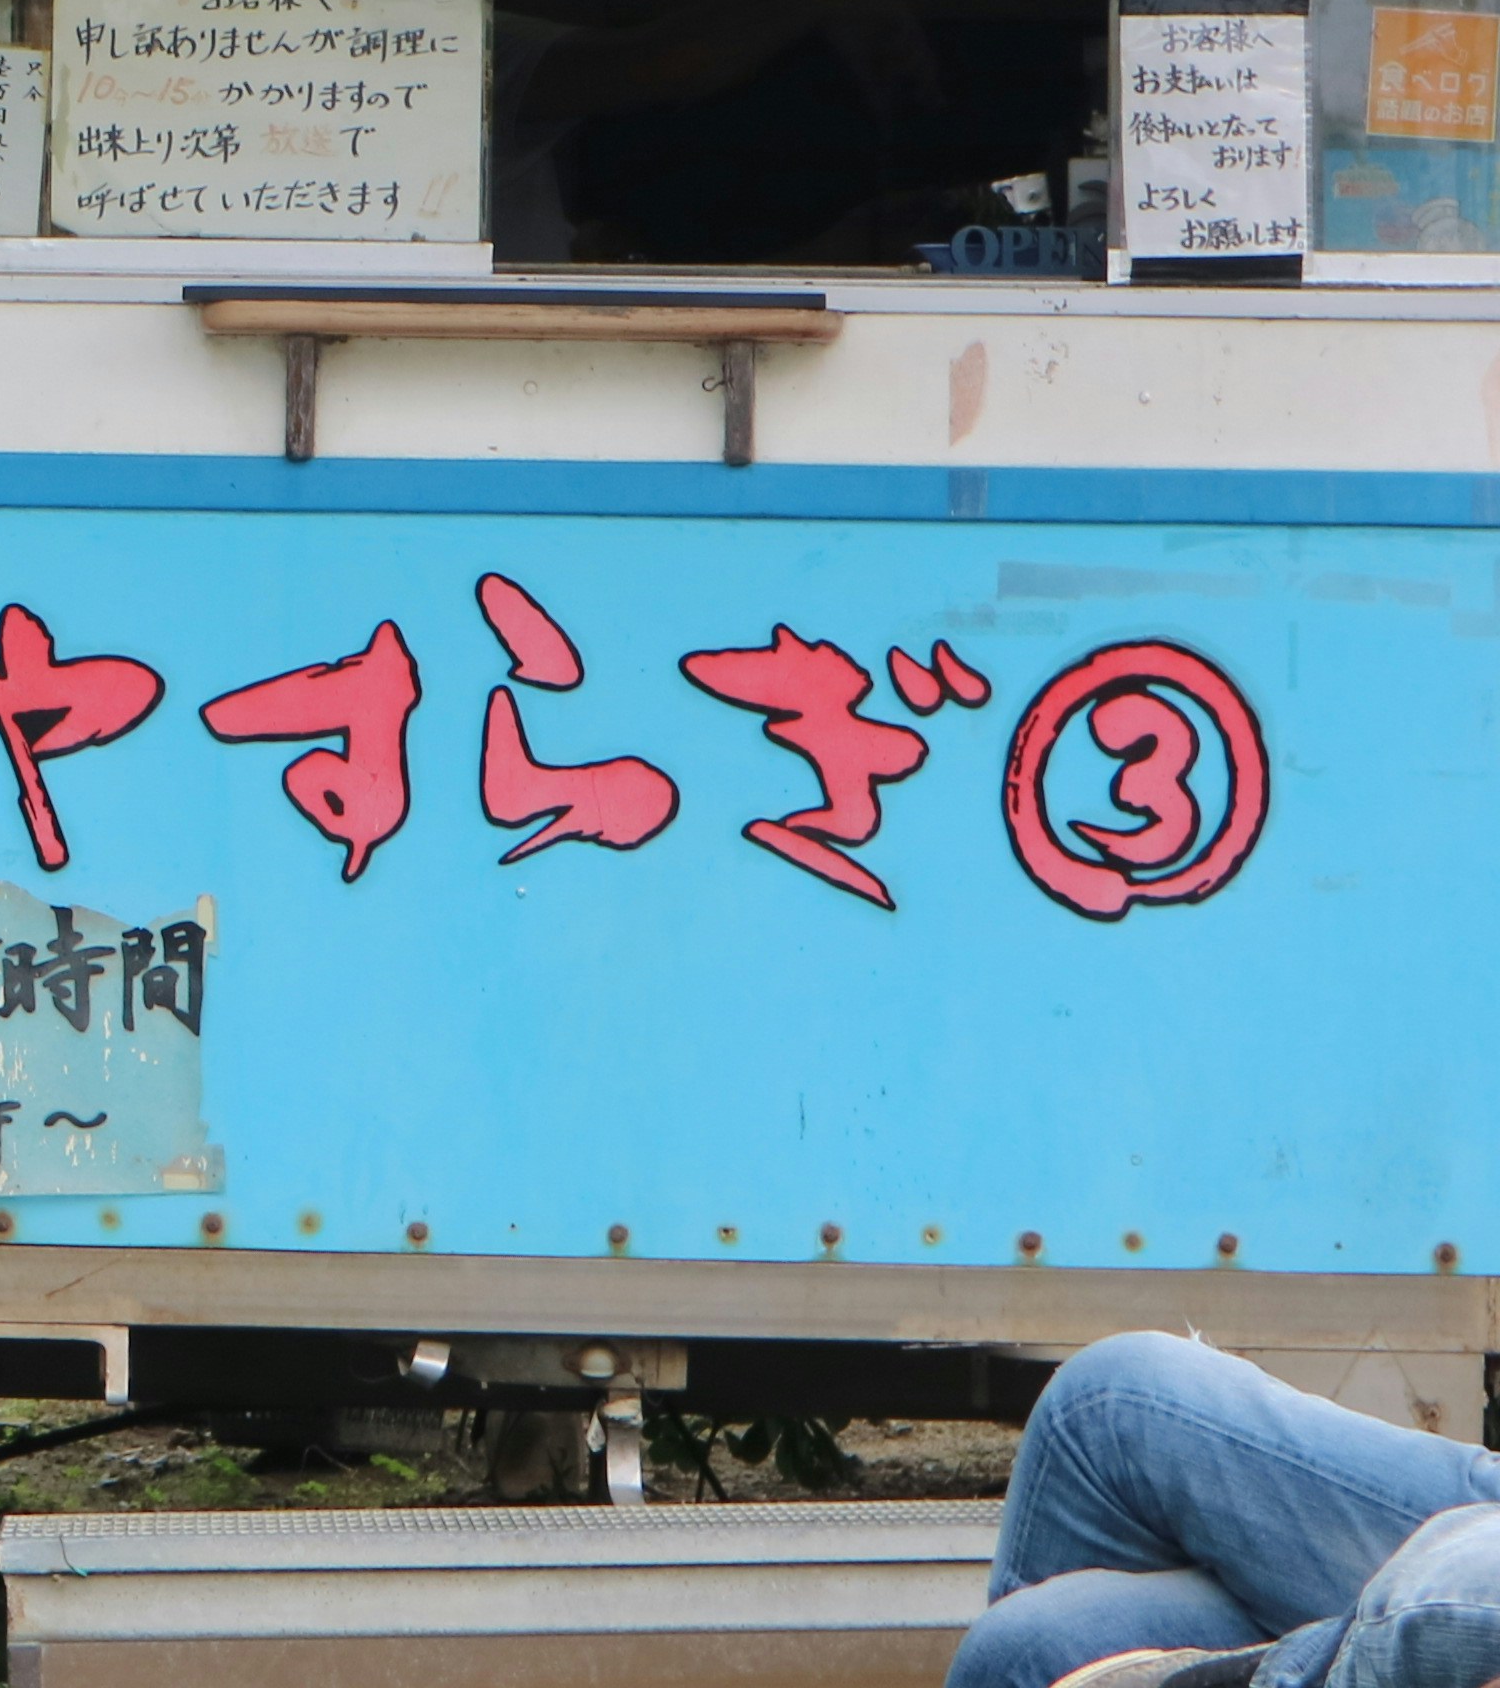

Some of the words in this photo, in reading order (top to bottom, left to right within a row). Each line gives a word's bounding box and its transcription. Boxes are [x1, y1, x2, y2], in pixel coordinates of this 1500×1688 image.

[76, 17, 460, 65] 申し訳ありませんが調理に
[1161, 19, 1275, 54] お客様へ
[22, 63, 45, 102] 只今
[218, 79, 429, 113] かかりますので
[1132, 63, 1259, 95] お支払いは
[1378, 60, 1490, 97] 食べログ
[76, 123, 242, 165] 出来上り次第
[338, 126, 377, 158] で
[1129, 111, 1279, 146] 後払いとなって
[1138, 182, 1217, 210] よろしく
